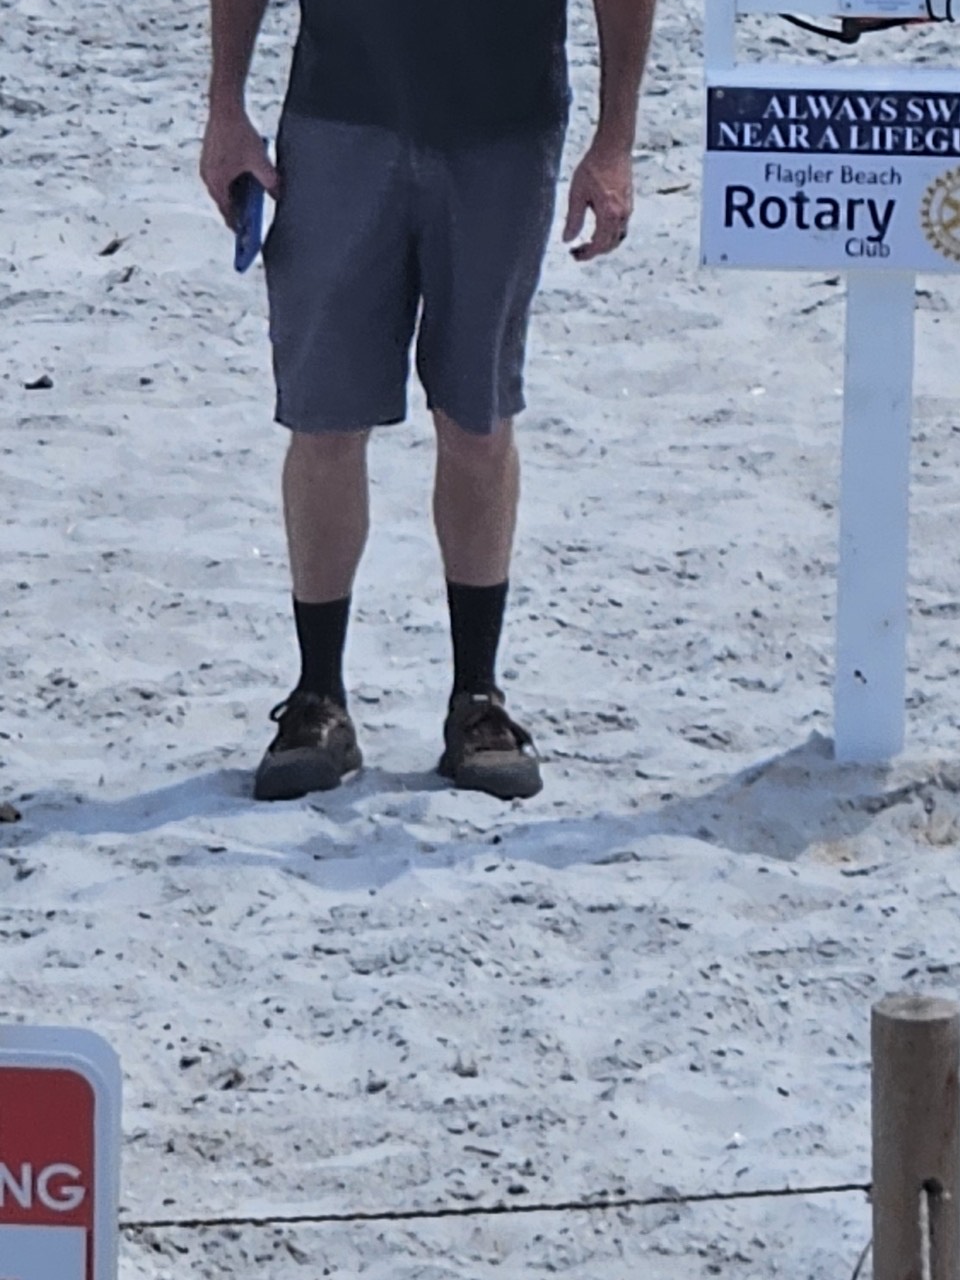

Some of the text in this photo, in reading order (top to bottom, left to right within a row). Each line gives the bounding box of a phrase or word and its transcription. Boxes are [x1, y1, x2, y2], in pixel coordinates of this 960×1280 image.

[762, 95, 900, 122] ALWAYS
[717, 121, 811, 150] NEAR
[817, 125, 842, 151] A
[764, 162, 902, 188] Flagler Beach
[723, 184, 898, 243] Rotary
[845, 237, 891, 259] Club
